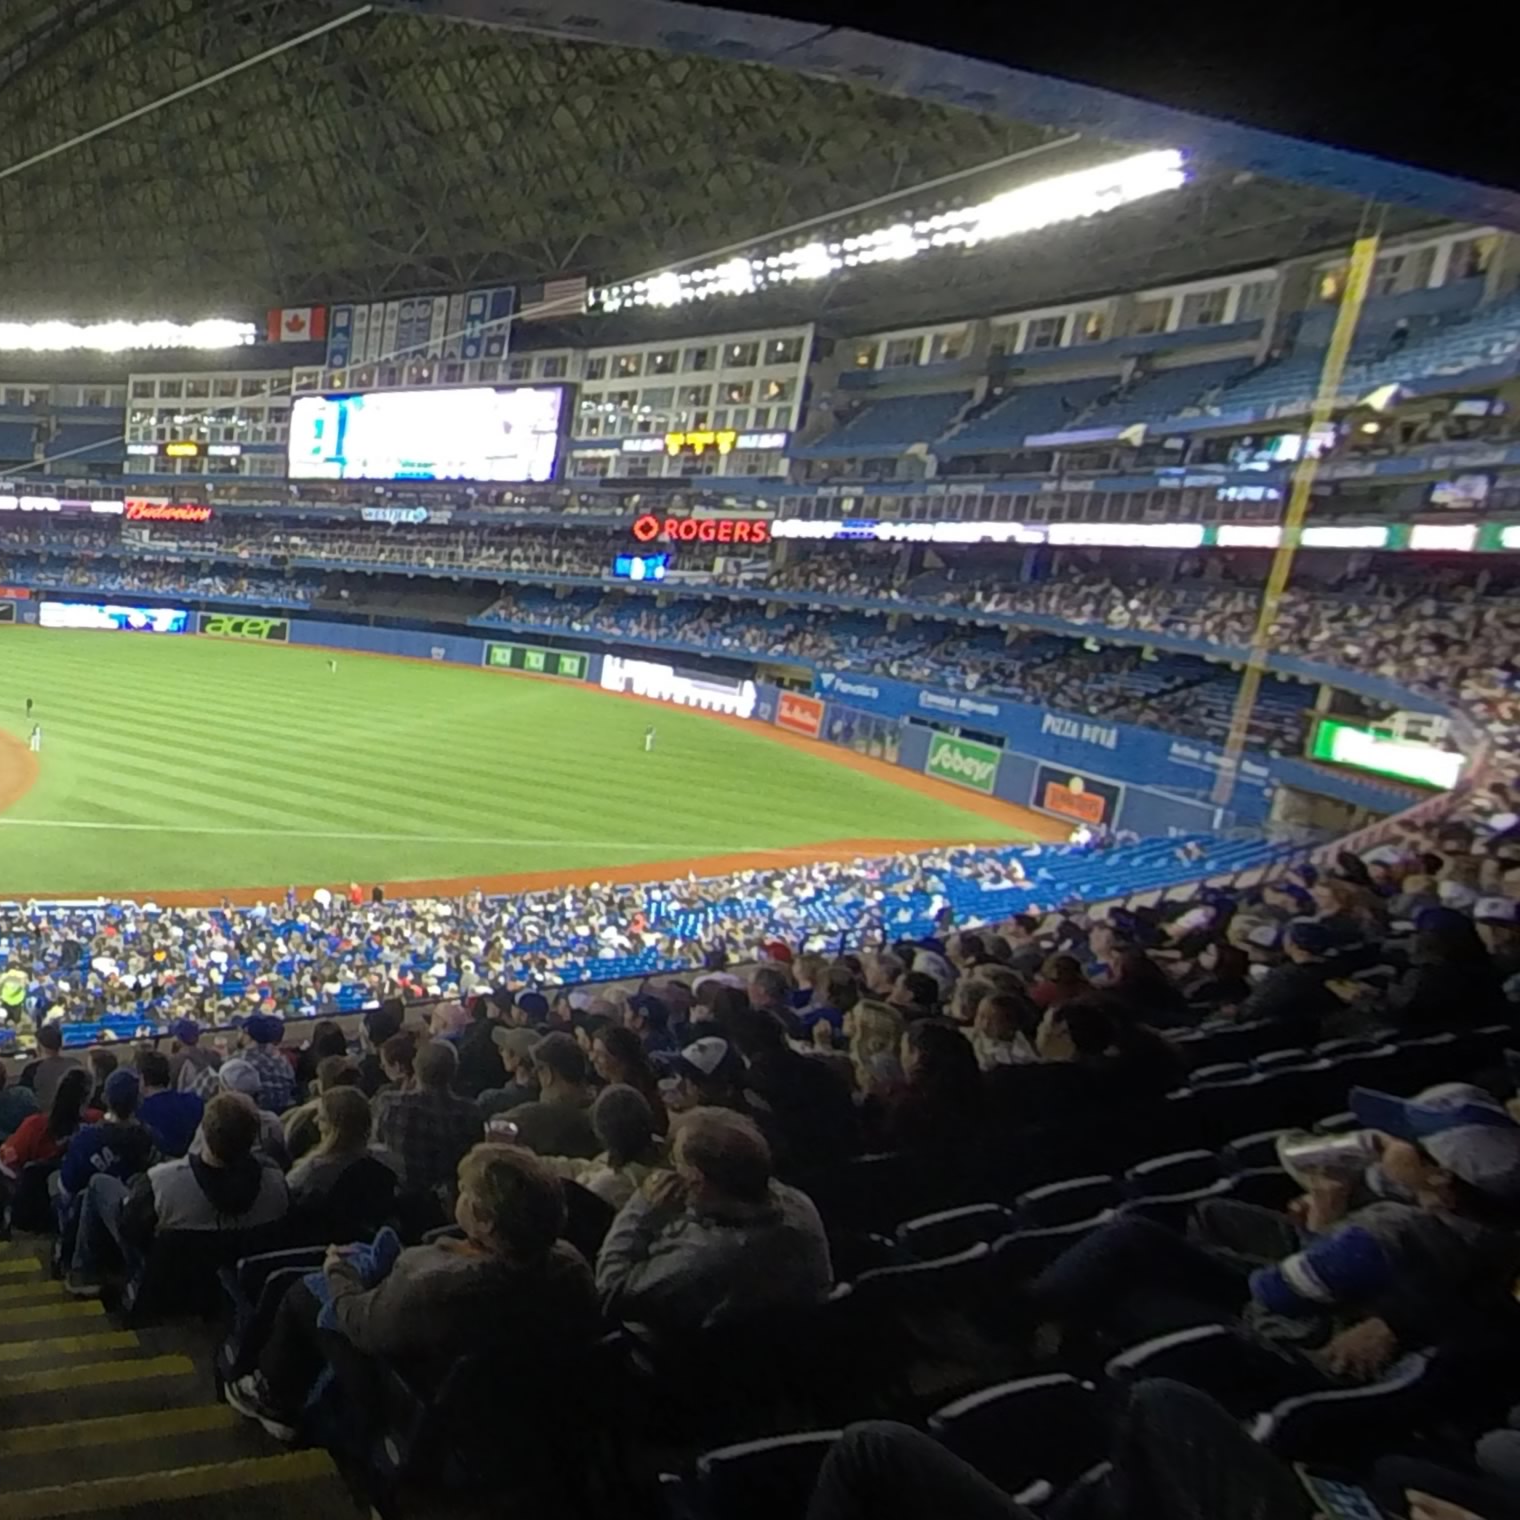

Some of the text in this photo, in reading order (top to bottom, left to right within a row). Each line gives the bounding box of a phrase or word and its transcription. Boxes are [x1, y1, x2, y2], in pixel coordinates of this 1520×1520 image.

[125, 500, 211, 520] Budweiser
[665, 518, 767, 543] ROGERS
[205, 615, 280, 639] acer
[1041, 714, 1079, 738] PIZZA
[931, 744, 994, 782] Sobeys
